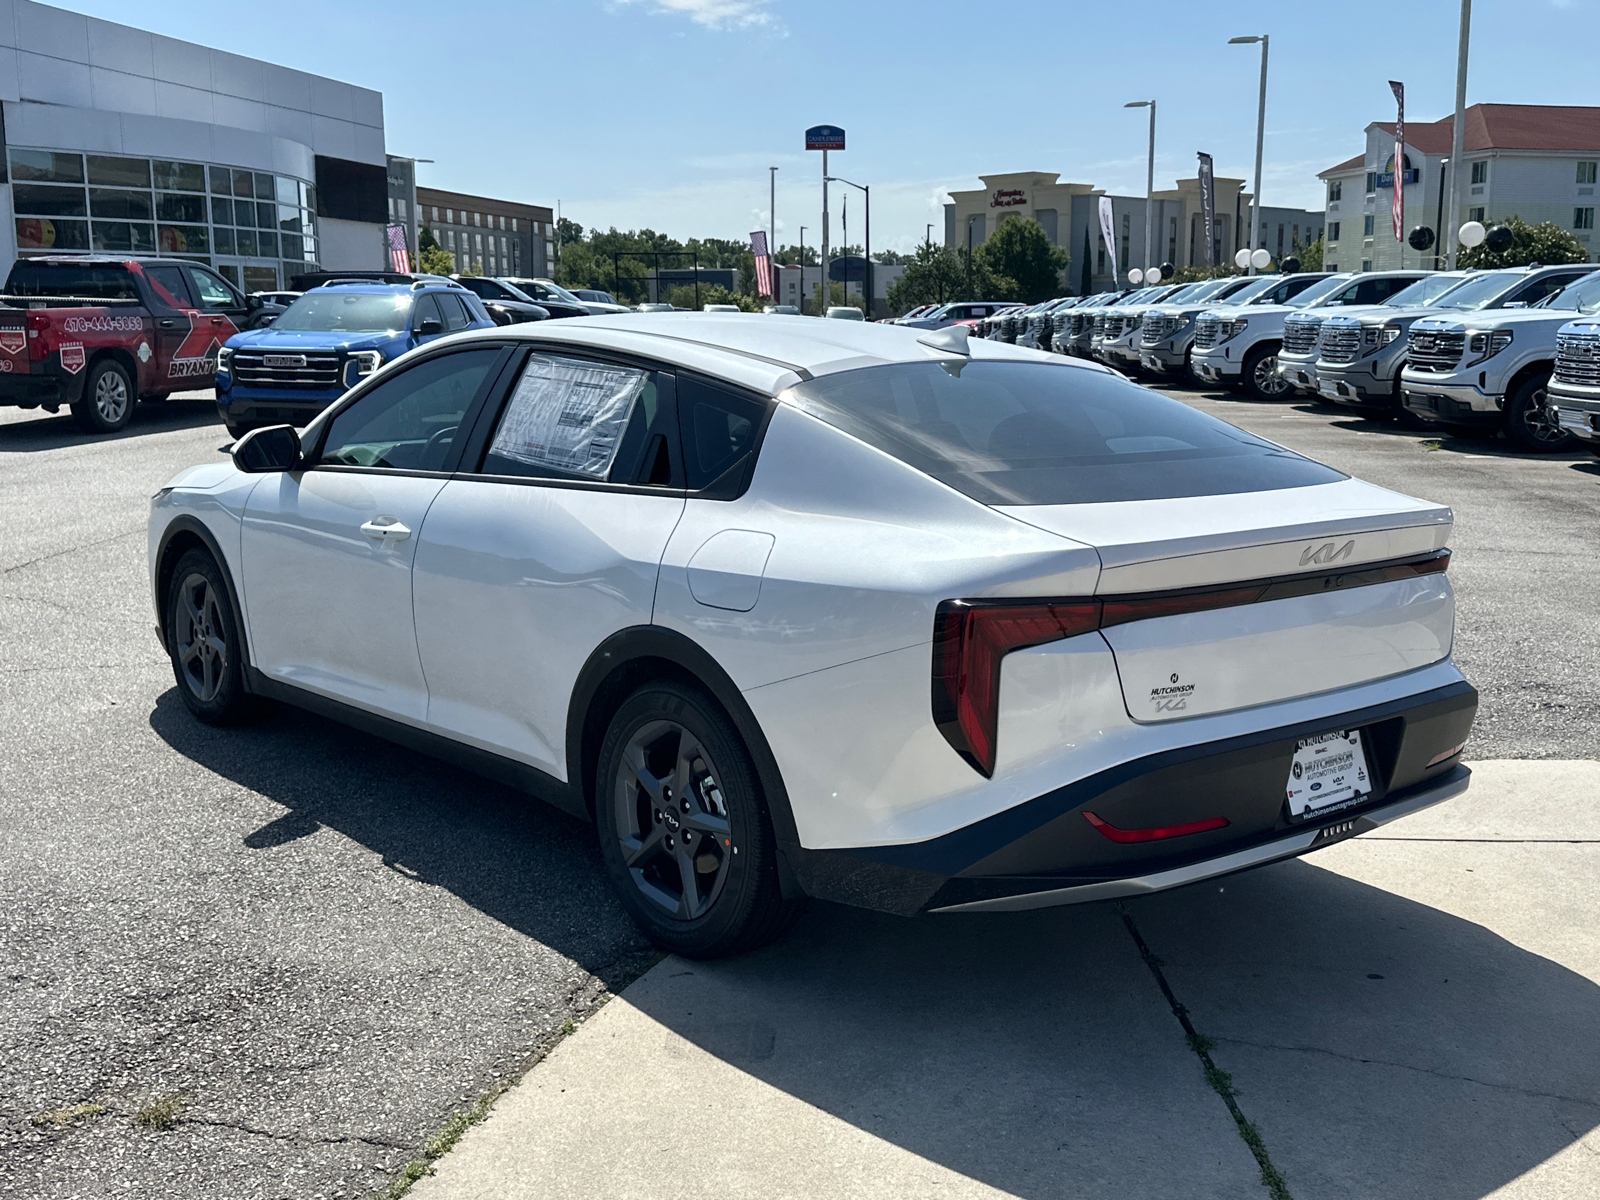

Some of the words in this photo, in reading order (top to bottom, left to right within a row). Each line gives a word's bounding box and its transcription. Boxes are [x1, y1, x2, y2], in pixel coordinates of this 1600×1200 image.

[64, 315, 143, 333] 478-444-5859
[167, 358, 214, 378] BRYANT
[1299, 540, 1356, 567] KIA
[1151, 684, 1196, 696] HUTCHINSON
[1151, 693, 1178, 701] AUTOMOTIVE
[1155, 698, 1187, 713] K4
[1307, 730, 1346, 747] HUTCHINSON
[1304, 751, 1354, 774] HUTCHINSON
[1307, 766, 1338, 781] AUTOMOTIVE
[1337, 761, 1354, 773] GROUP
[1303, 795, 1369, 820] Hutchinsonautogroup.com
